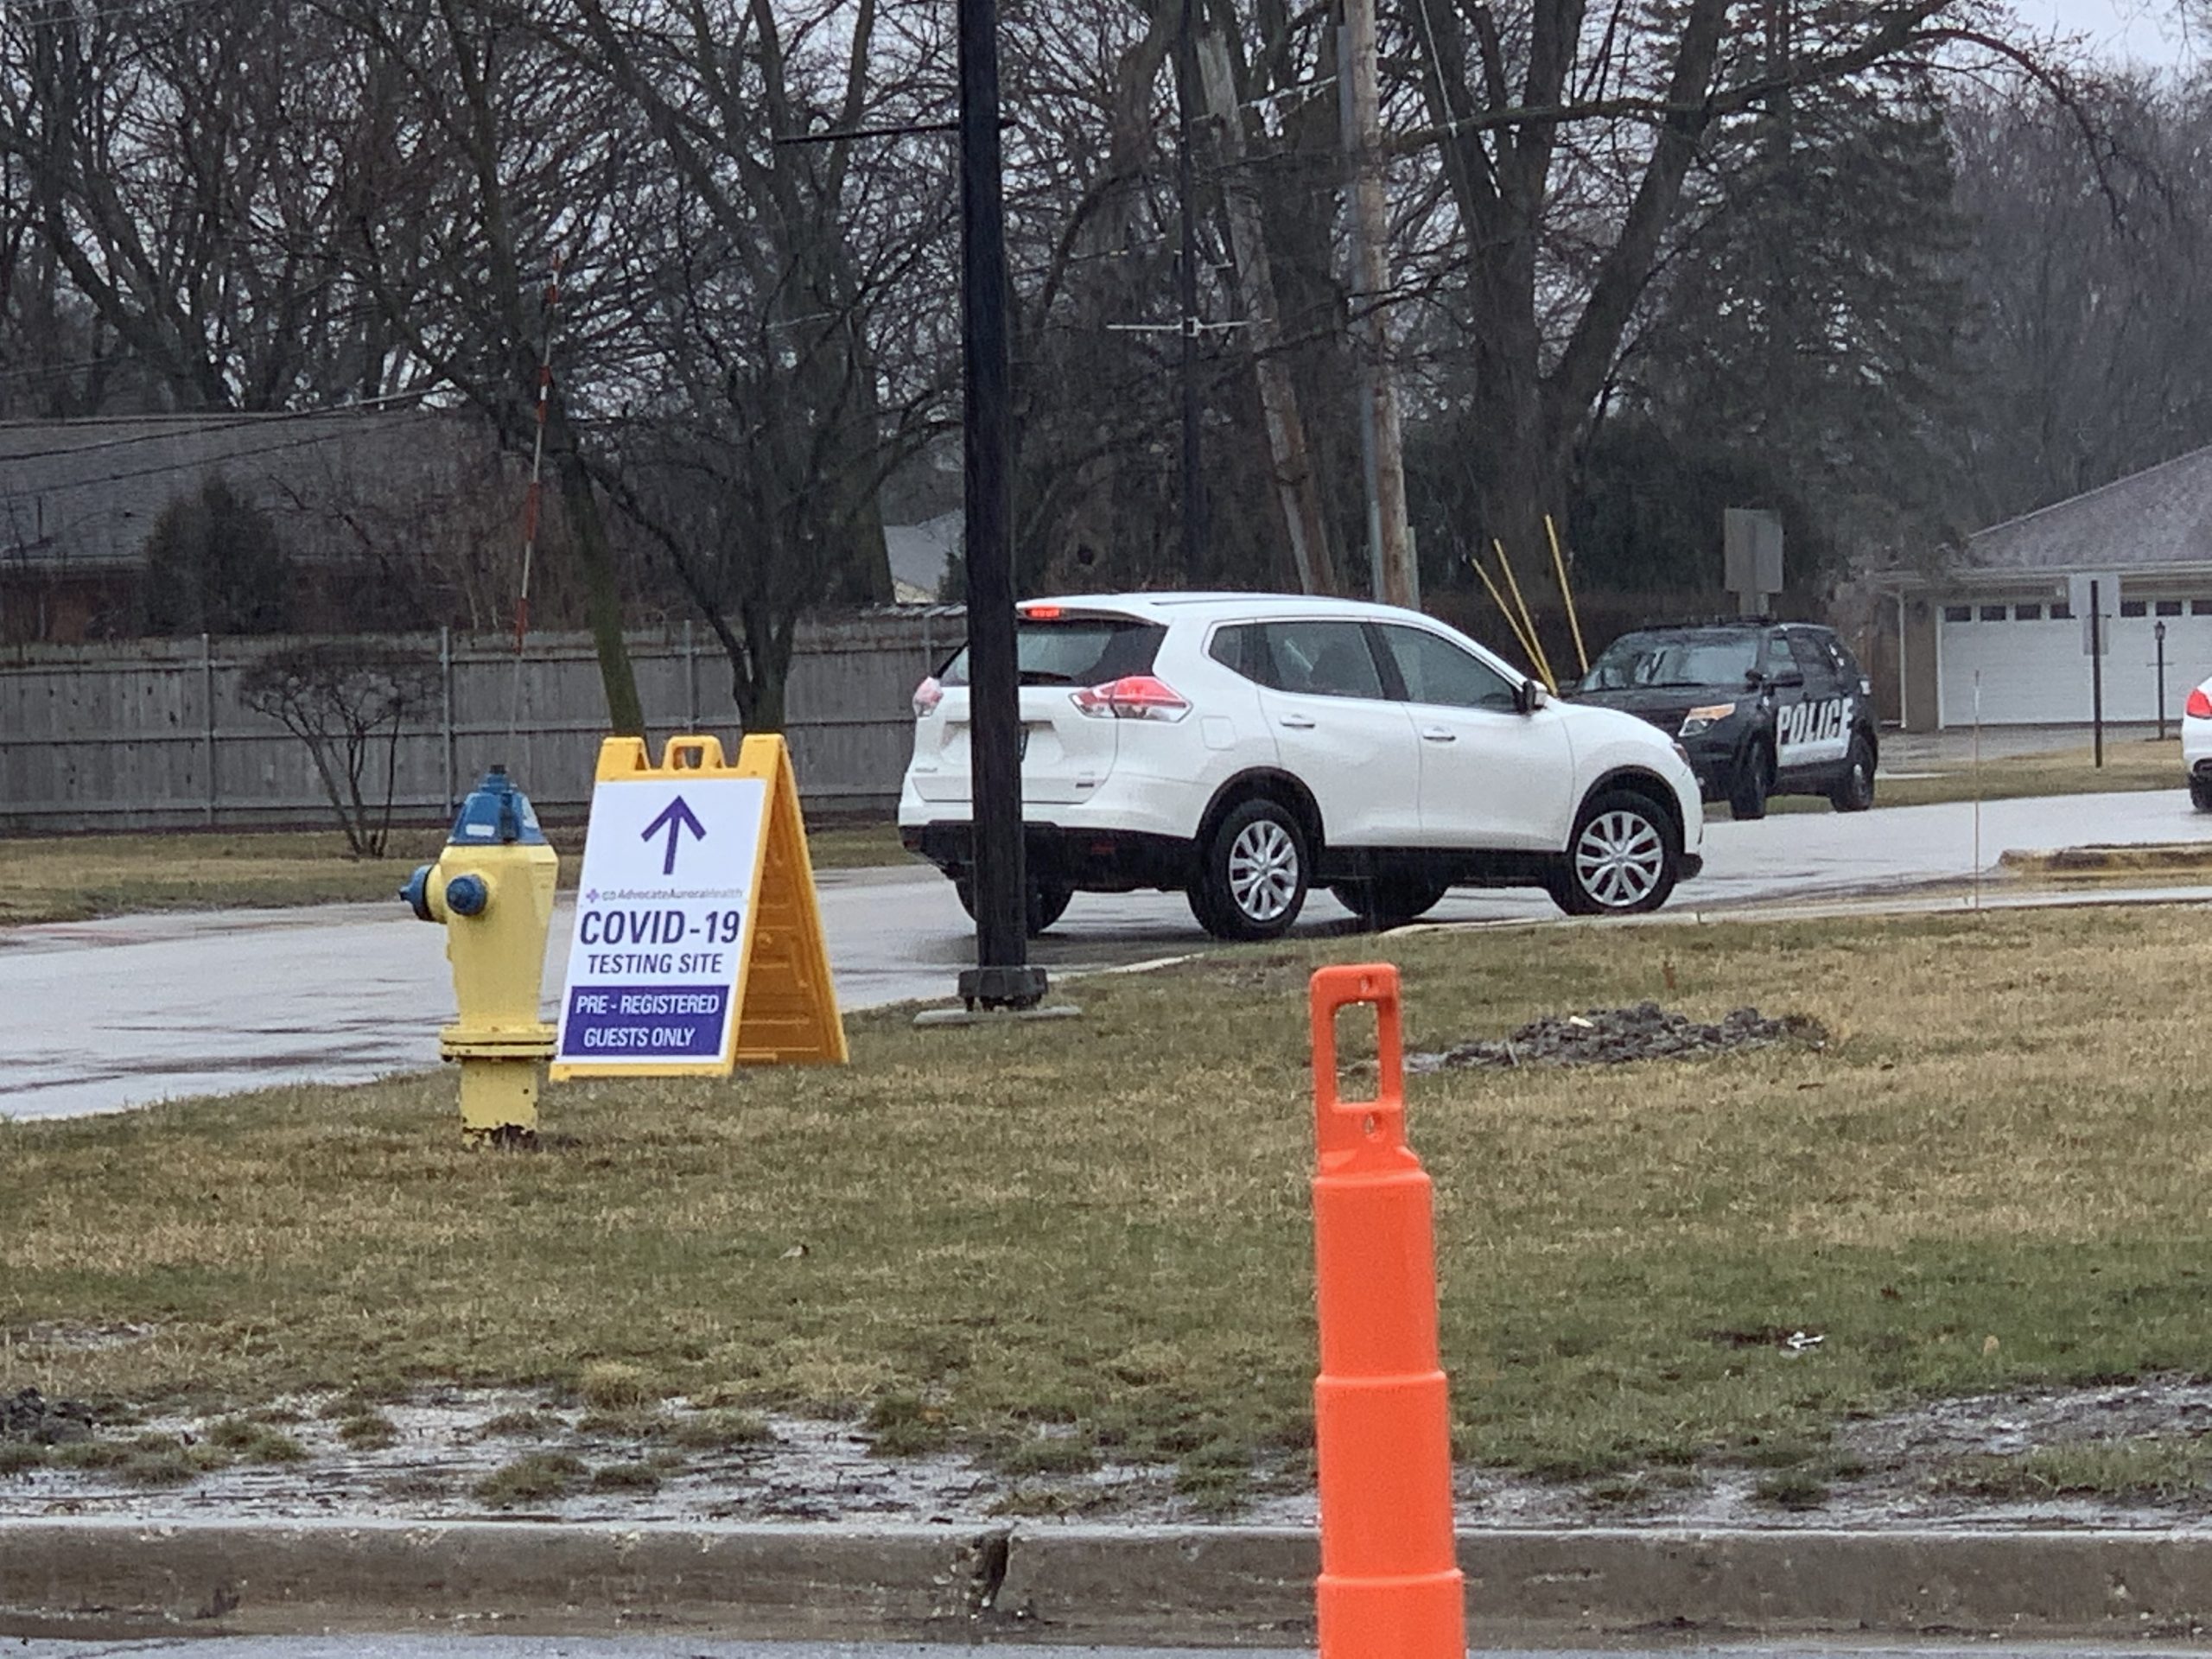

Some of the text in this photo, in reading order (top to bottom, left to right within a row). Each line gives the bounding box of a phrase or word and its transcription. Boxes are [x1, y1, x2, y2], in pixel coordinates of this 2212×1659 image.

[1777, 698, 1853, 745] POLICE
[580, 910, 741, 945] COVID-19
[588, 952, 724, 975] TESTING SITE
[583, 1027, 696, 1047] GUESTS ONLY
